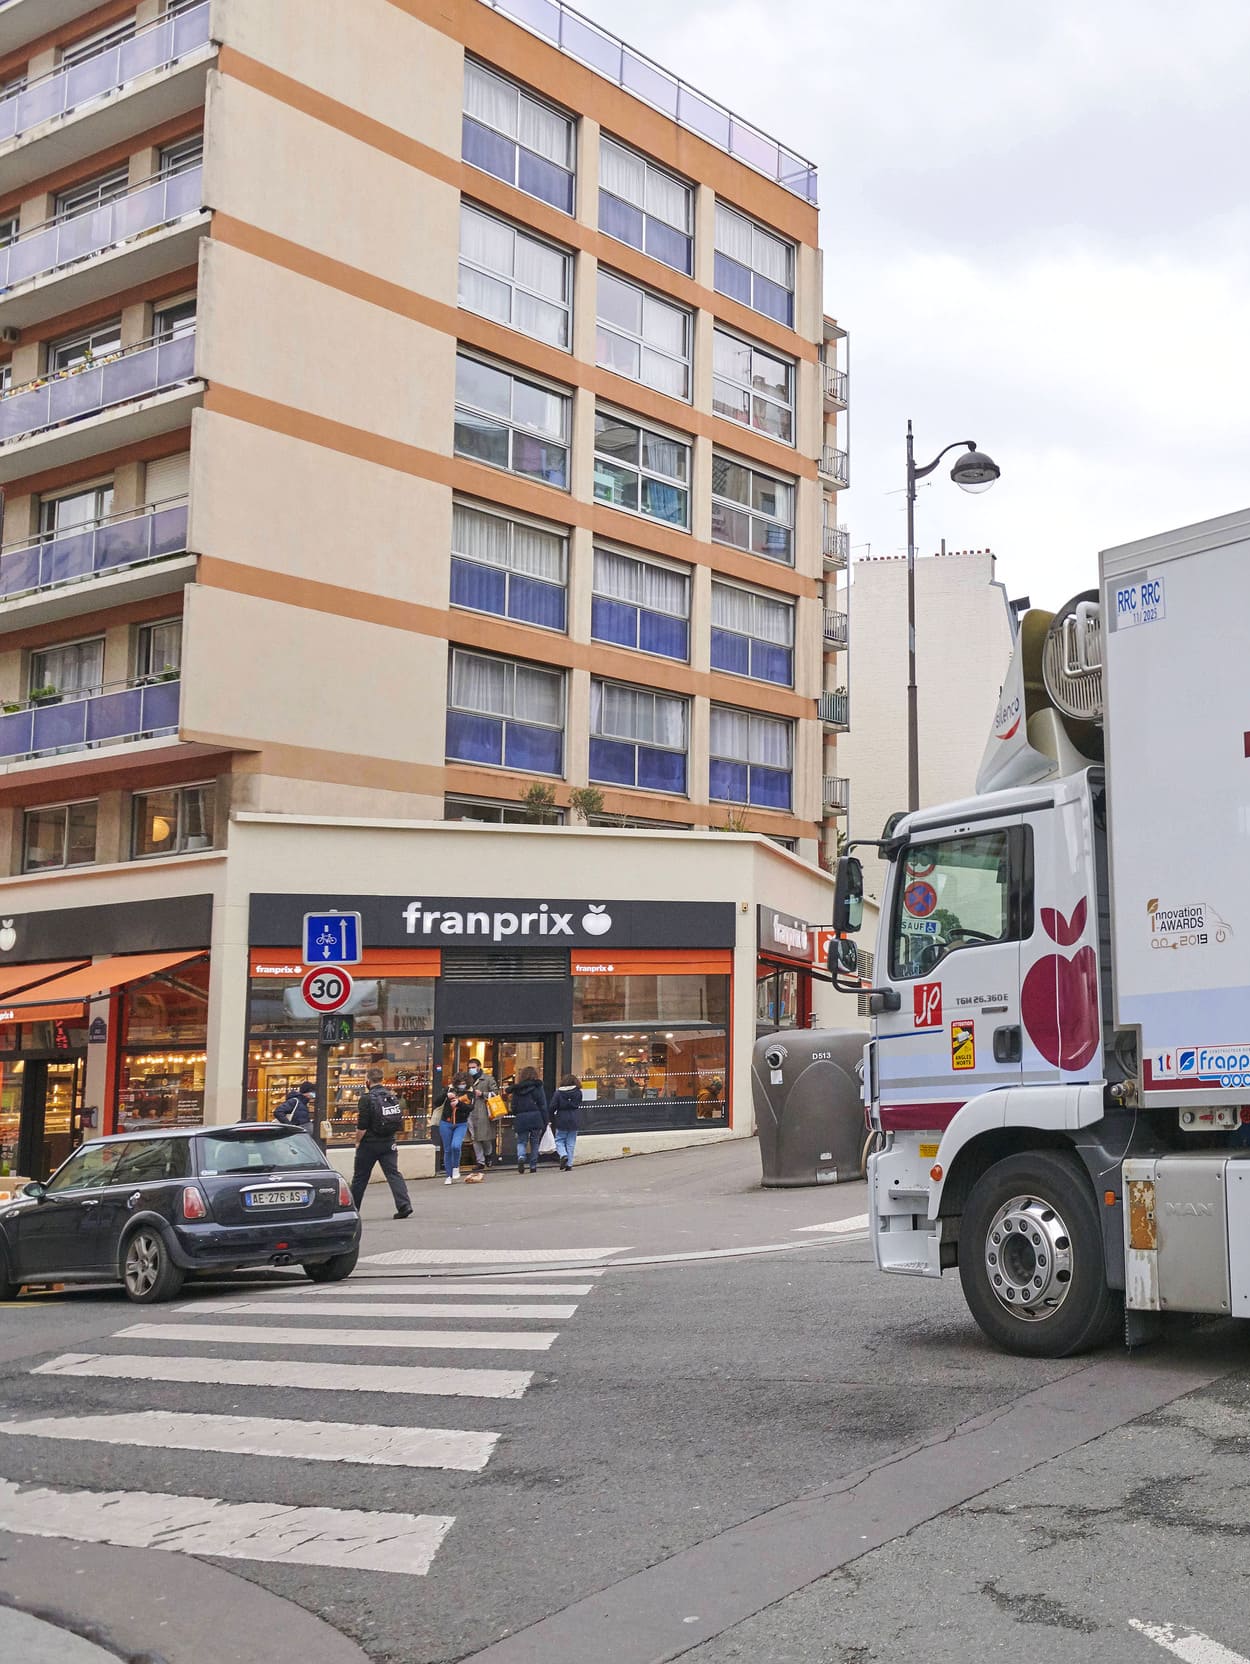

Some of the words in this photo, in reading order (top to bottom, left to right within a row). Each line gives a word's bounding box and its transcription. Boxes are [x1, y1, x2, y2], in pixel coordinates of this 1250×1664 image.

[1118, 588, 1136, 612] RRC
[1141, 581, 1160, 608] RRC
[402, 902, 575, 942] franprix
[901, 921, 925, 930] SAUF
[1179, 934, 1208, 947] 2019
[255, 965, 293, 975] franprix
[575, 964, 607, 973] franprix
[311, 979, 342, 999] 30
